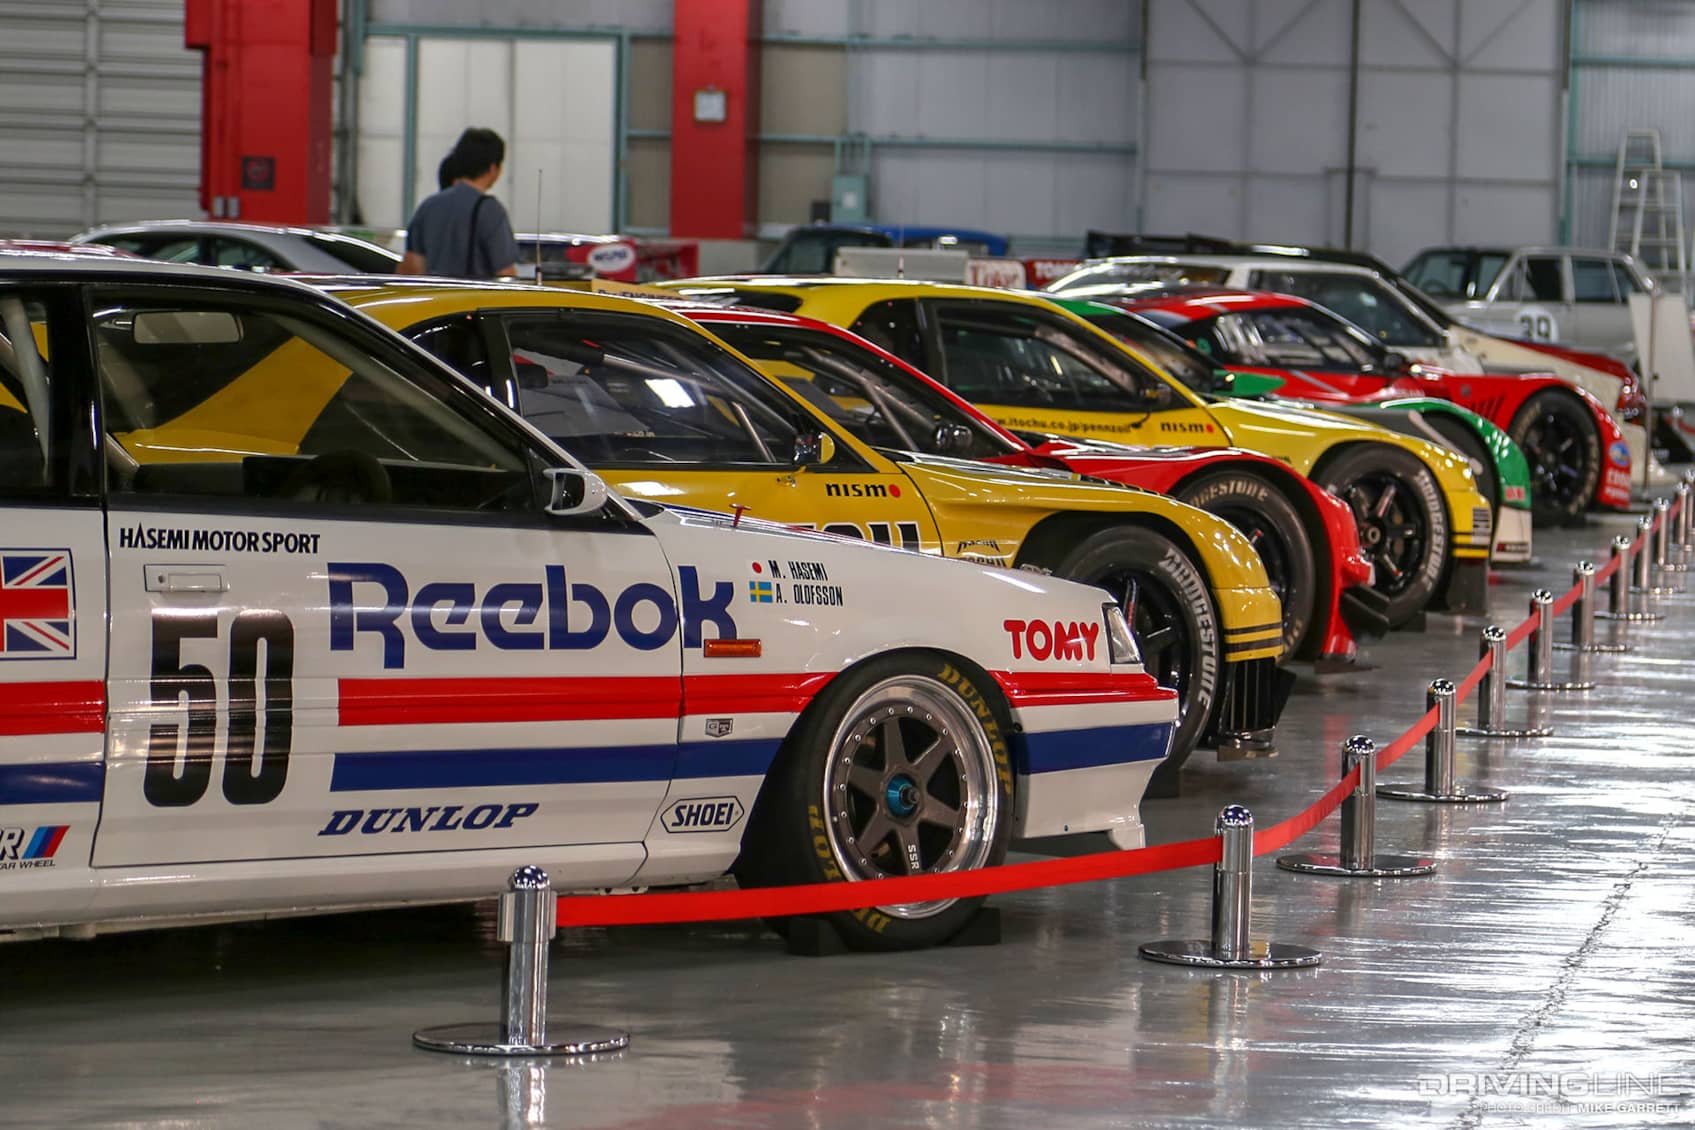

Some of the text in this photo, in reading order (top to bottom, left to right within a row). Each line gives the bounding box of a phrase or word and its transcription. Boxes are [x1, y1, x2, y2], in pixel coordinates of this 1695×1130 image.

[120, 522, 321, 554] HASEMI MOTOR SPORT
[768, 560, 829, 581] M. HASEMI
[776, 583, 844, 607] A. OLOFSSON
[327, 562, 738, 669] Reebok
[1003, 619, 1099, 661] TOMY
[144, 607, 295, 807] 50
[937, 663, 1013, 795] DUNLOP
[317, 803, 540, 836] DUNLOP
[671, 803, 735, 827] SHOEI
[0, 828, 25, 860] R
[907, 844, 920, 870] SSR
[19, 860, 56, 869] WHEEL
